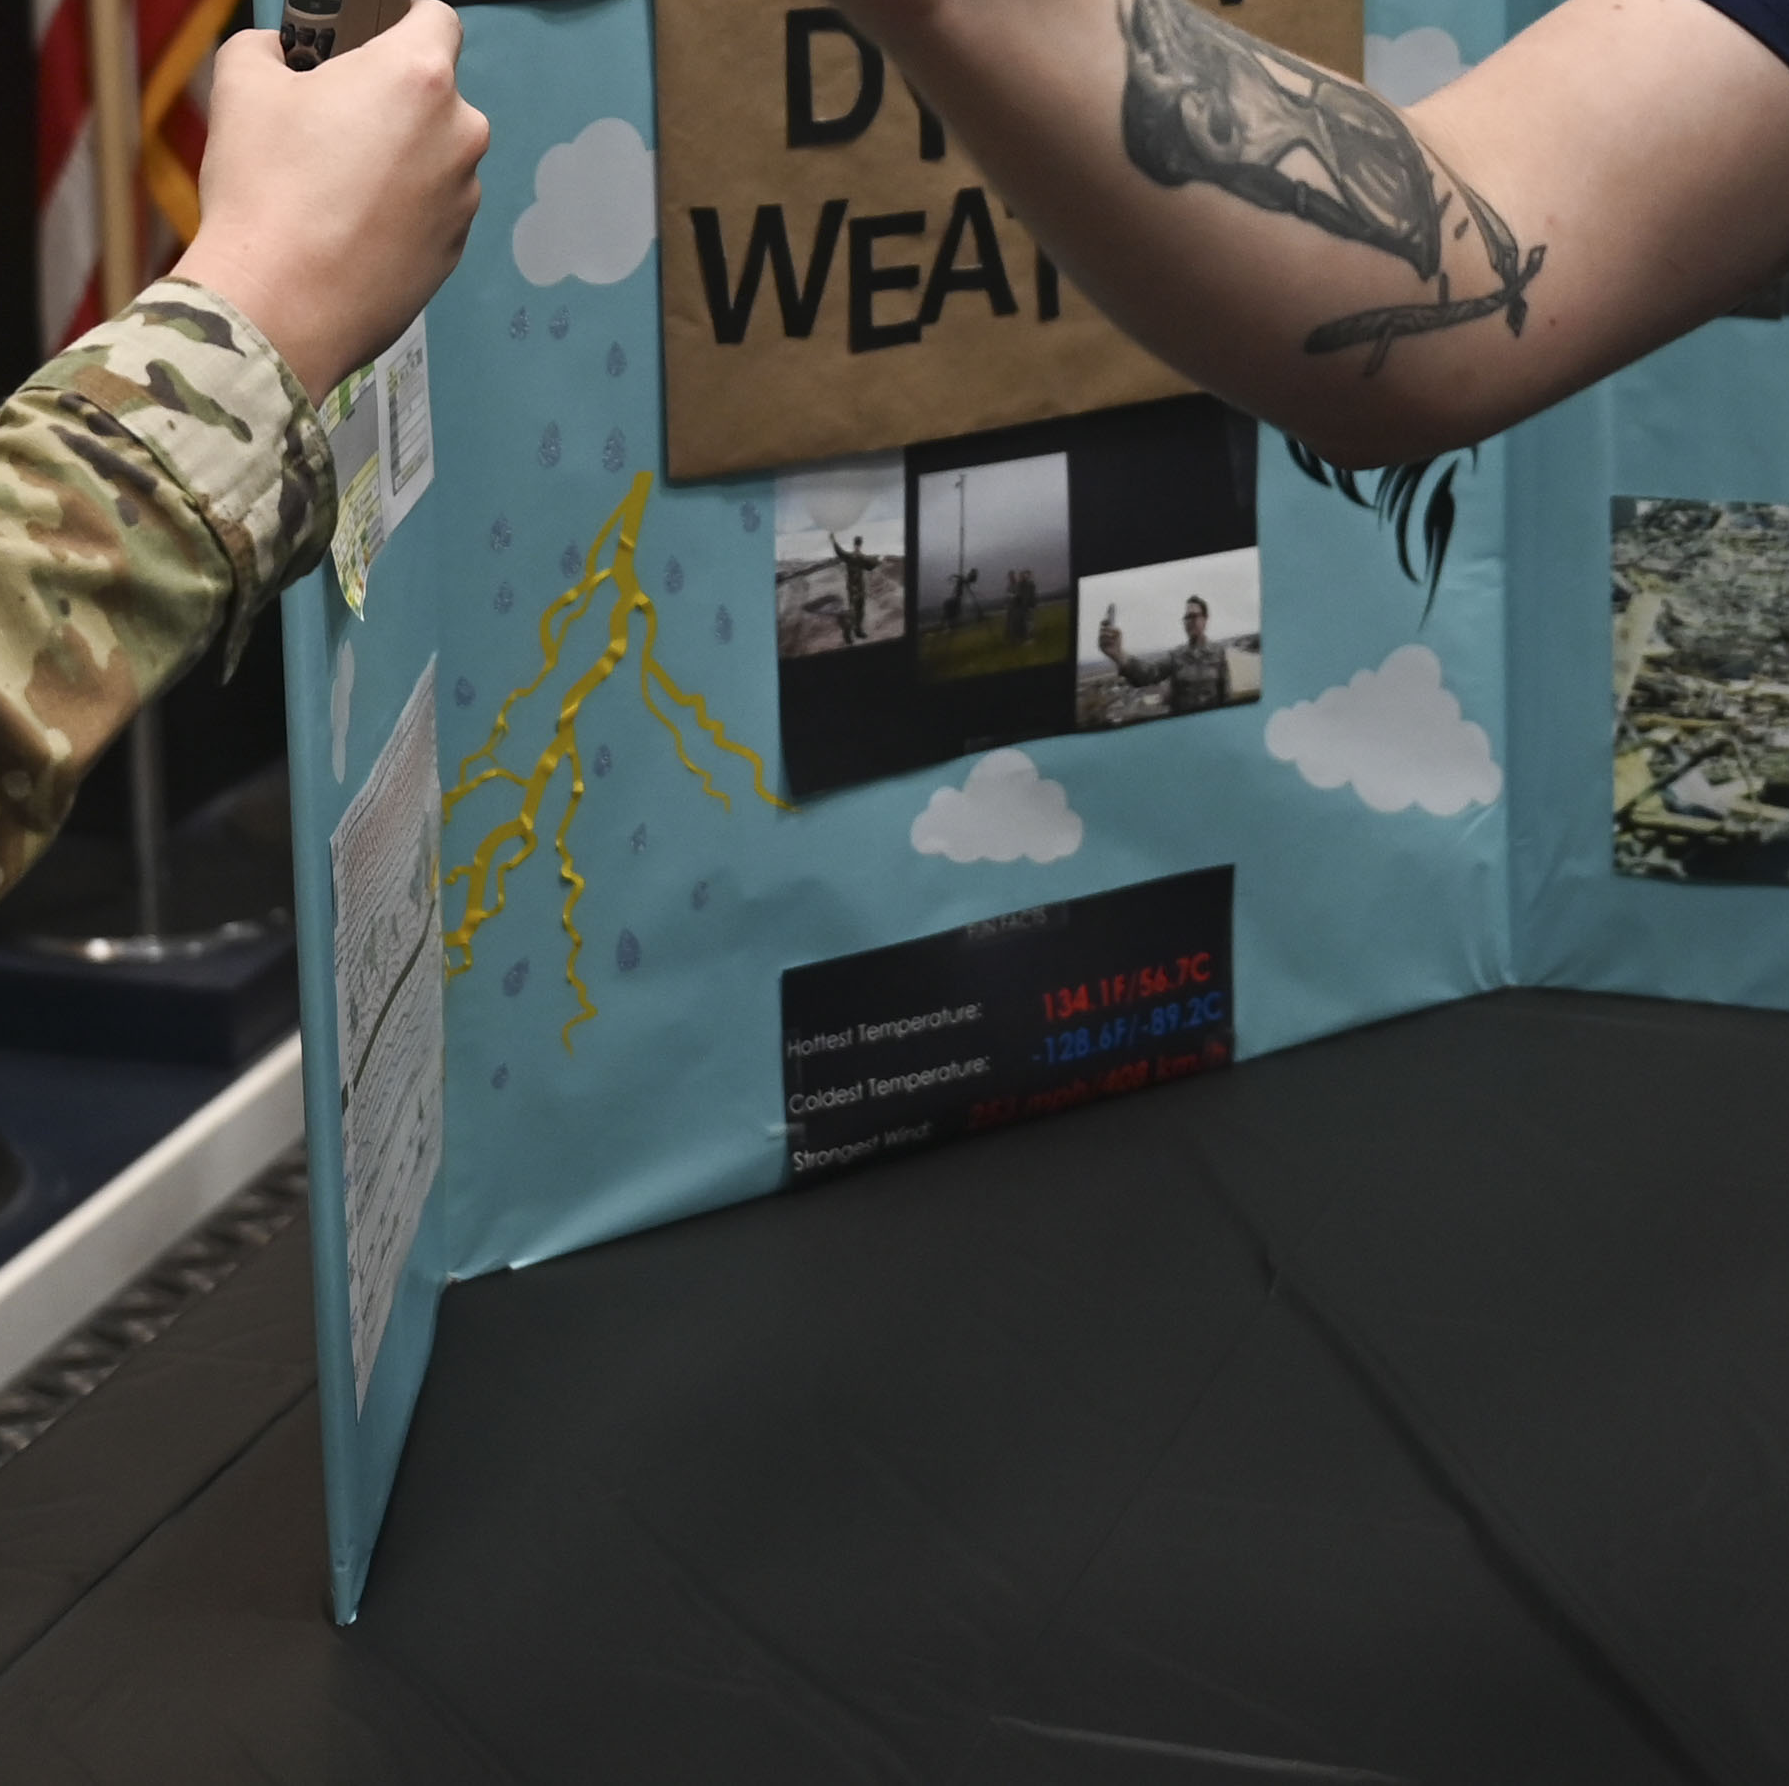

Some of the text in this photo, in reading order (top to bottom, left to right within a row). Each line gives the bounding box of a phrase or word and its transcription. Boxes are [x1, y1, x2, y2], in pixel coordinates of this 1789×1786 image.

[787, 952, 1212, 1058] Hottest Temperature: 134.1F/56.7C
[788, 992, 1224, 1114] Coldest Temperature: -128.6F/-89.2C
[792, 1134, 880, 1172] Strongest
